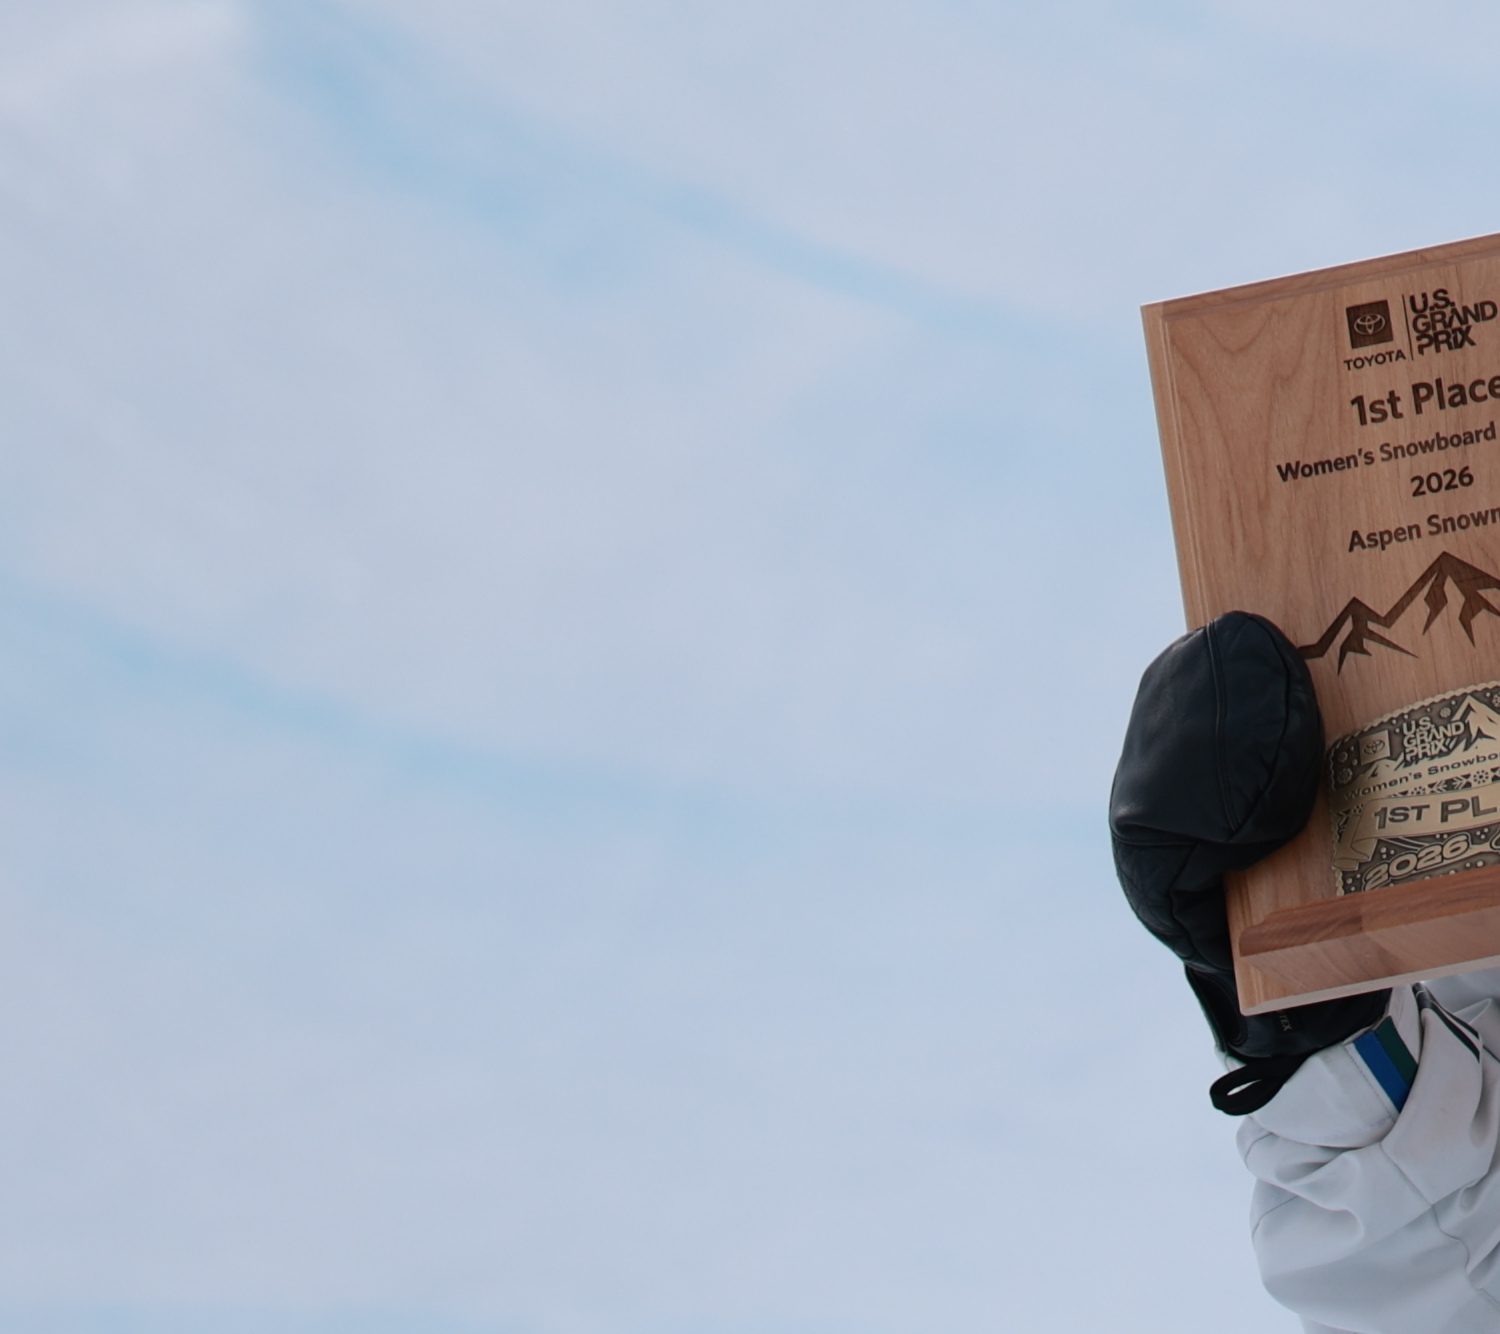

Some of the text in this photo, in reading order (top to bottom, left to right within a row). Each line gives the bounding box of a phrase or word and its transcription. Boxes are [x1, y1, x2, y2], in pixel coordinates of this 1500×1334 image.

[1410, 289, 1455, 314] U.S.
[1413, 300, 1498, 336] GRAND
[1416, 326, 1476, 356] PRIX
[1343, 349, 1406, 371] TOYOTA
[1350, 390, 1403, 426] 1st
[1277, 448, 1374, 482] Women's
[1379, 421, 1496, 463] Snowboard
[1411, 466, 1474, 497] 2026
[1348, 522, 1421, 553] Aspen
[1402, 721, 1465, 749] GRAND
[1403, 716, 1435, 735] U.S.
[1404, 738, 1450, 761] PRIX
[1345, 770, 1422, 800] Women's
[1374, 804, 1430, 829] 1ST
[1363, 835, 1470, 891] 2026
